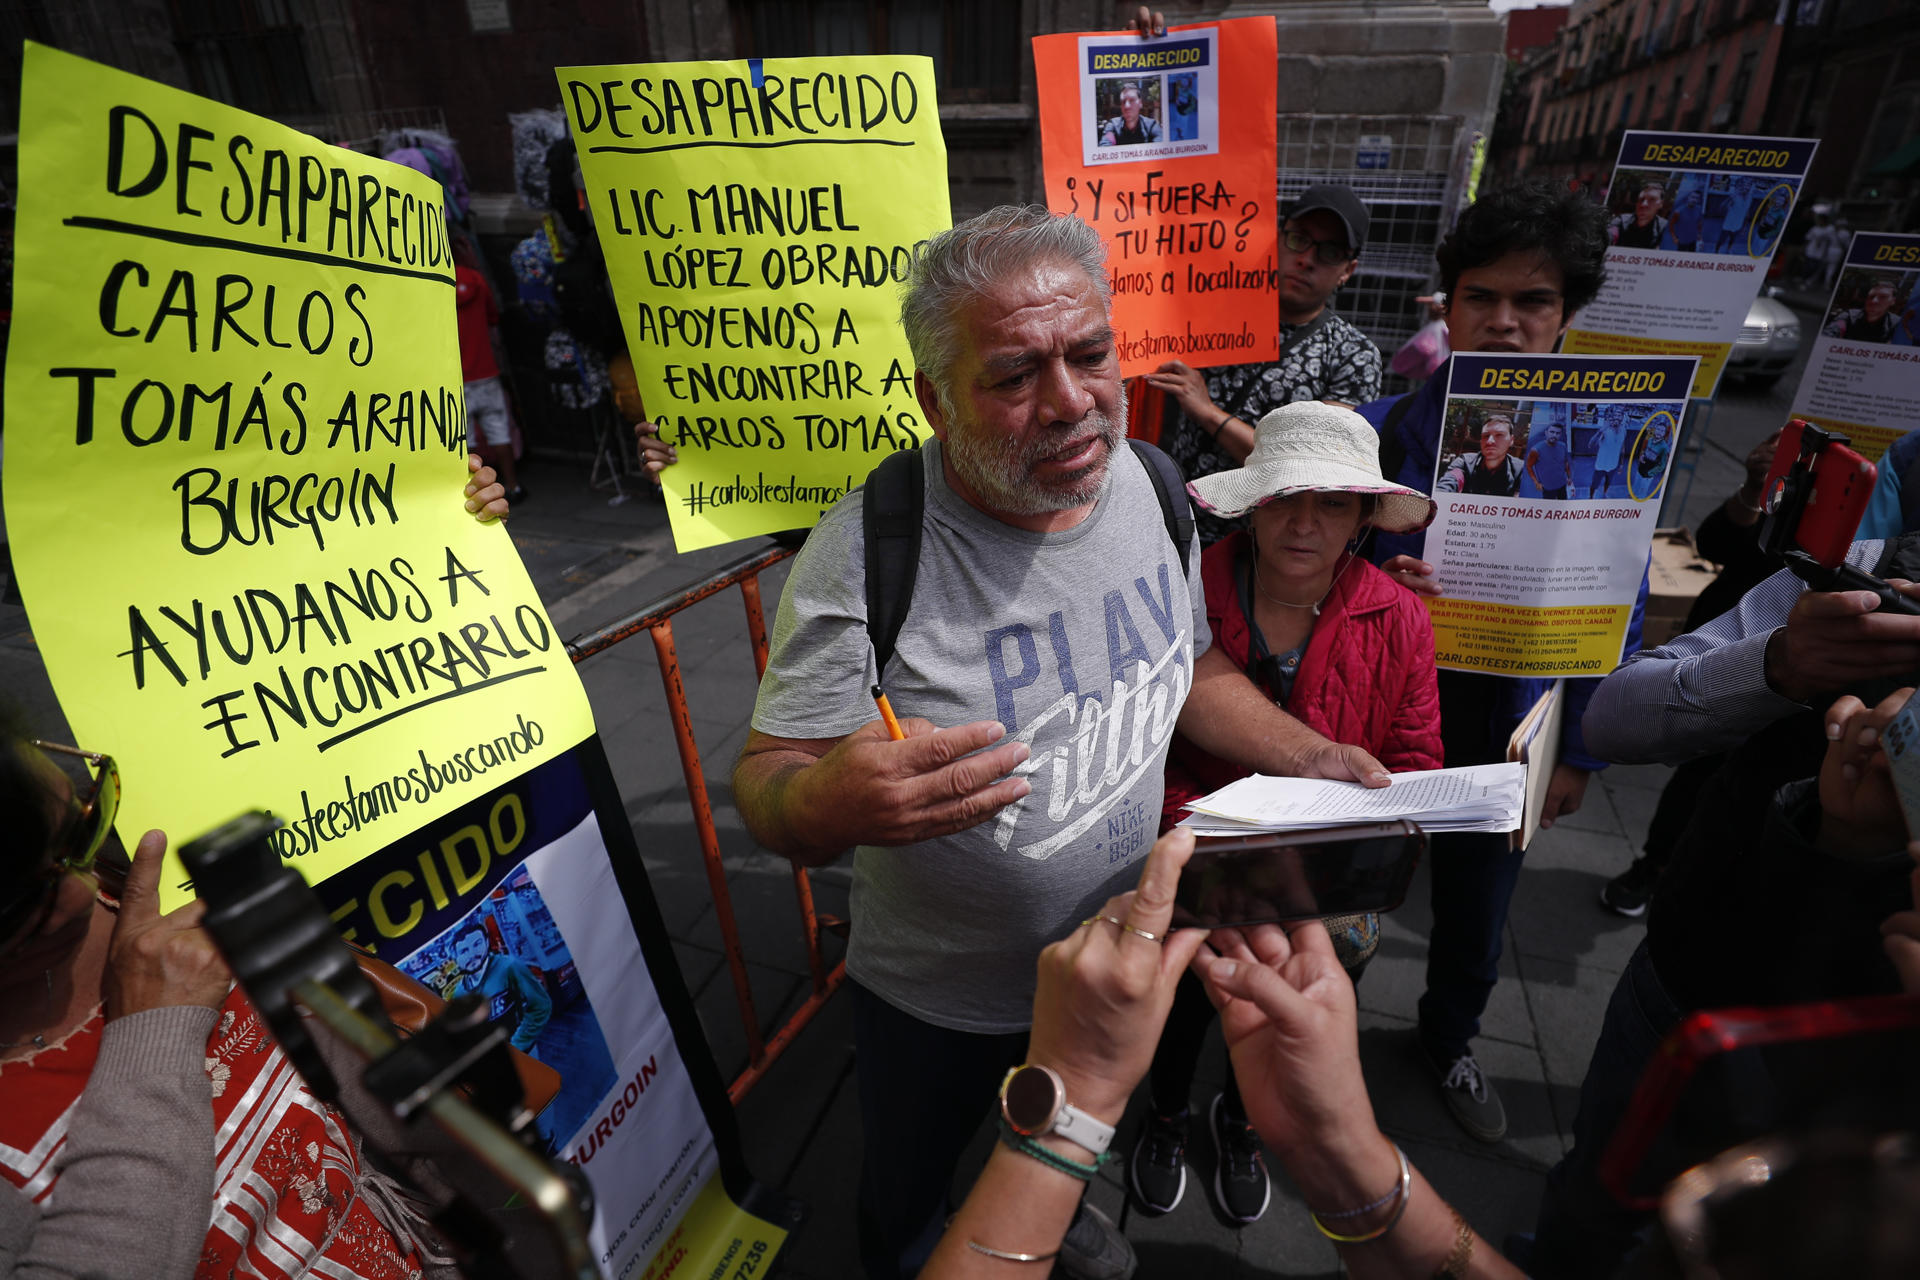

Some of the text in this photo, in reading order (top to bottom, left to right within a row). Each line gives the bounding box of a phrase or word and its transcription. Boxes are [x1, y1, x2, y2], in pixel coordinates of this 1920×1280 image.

[1094, 48, 1200, 70] DESAPARECIDO
[568, 70, 918, 139] DESAPARECIDO
[1092, 151, 1119, 161] CARLOS
[1643, 143, 1790, 168] DESAPARECIDO
[608, 183, 860, 240] LIC. MANUEL
[1114, 190, 1135, 222] SI
[1142, 171, 1236, 216] FUERA
[1115, 228, 1148, 259] TU
[643, 244, 751, 289] LÓPEZ
[1109, 266, 1154, 296] danos
[1161, 270, 1174, 295] a
[1676, 260, 1714, 272] ARANDA
[1716, 262, 1756, 273] BURGOIN
[99, 259, 374, 368] CARLOS
[638, 302, 860, 355] APOYENOS A
[1116, 321, 1255, 362] steestamosbuscando
[1828, 345, 1871, 358] CARLOS
[663, 358, 912, 403] ENCONTRAR A
[1480, 368, 1666, 392] DESAPARECIDO
[49, 370, 467, 460] TOMÁS ARANDA
[653, 404, 919, 452] CARLOS TOMÁS
[172, 462, 399, 555] BURGOIN
[682, 471, 852, 516] #carlosteestamos
[1450, 502, 1641, 520] CARLOS TOMÁS ARANDA BURGOIN
[1446, 529, 1467, 537] Edad:
[1448, 519, 1506, 530] Sexo: Masculino
[117, 546, 490, 690] AYUDANOS A
[984, 563, 1184, 734] PLAY
[201, 604, 550, 759] ENCONTRARLO
[268, 713, 545, 859] osteestamosbuscando
